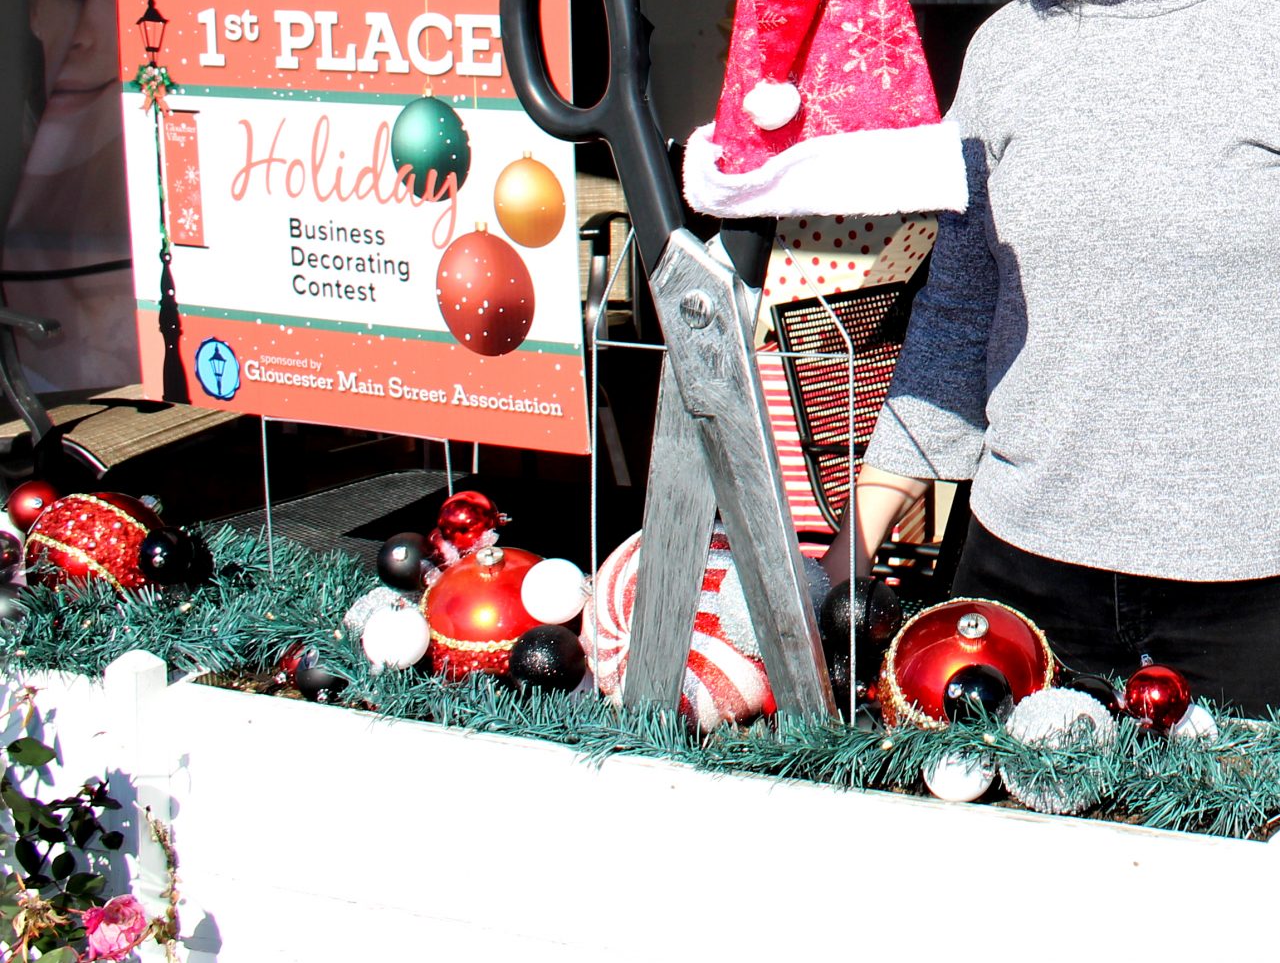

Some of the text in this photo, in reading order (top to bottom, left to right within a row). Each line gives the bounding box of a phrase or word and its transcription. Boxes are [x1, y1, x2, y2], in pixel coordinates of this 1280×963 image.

[197, 7, 503, 77] 1st PLACE
[231, 114, 458, 250] Holiday
[289, 217, 386, 246] Business
[290, 245, 410, 282] Decorating
[292, 274, 377, 303] Contest
[260, 354, 322, 372] sponsored by
[244, 359, 564, 417] Gloucester Main Street Association
